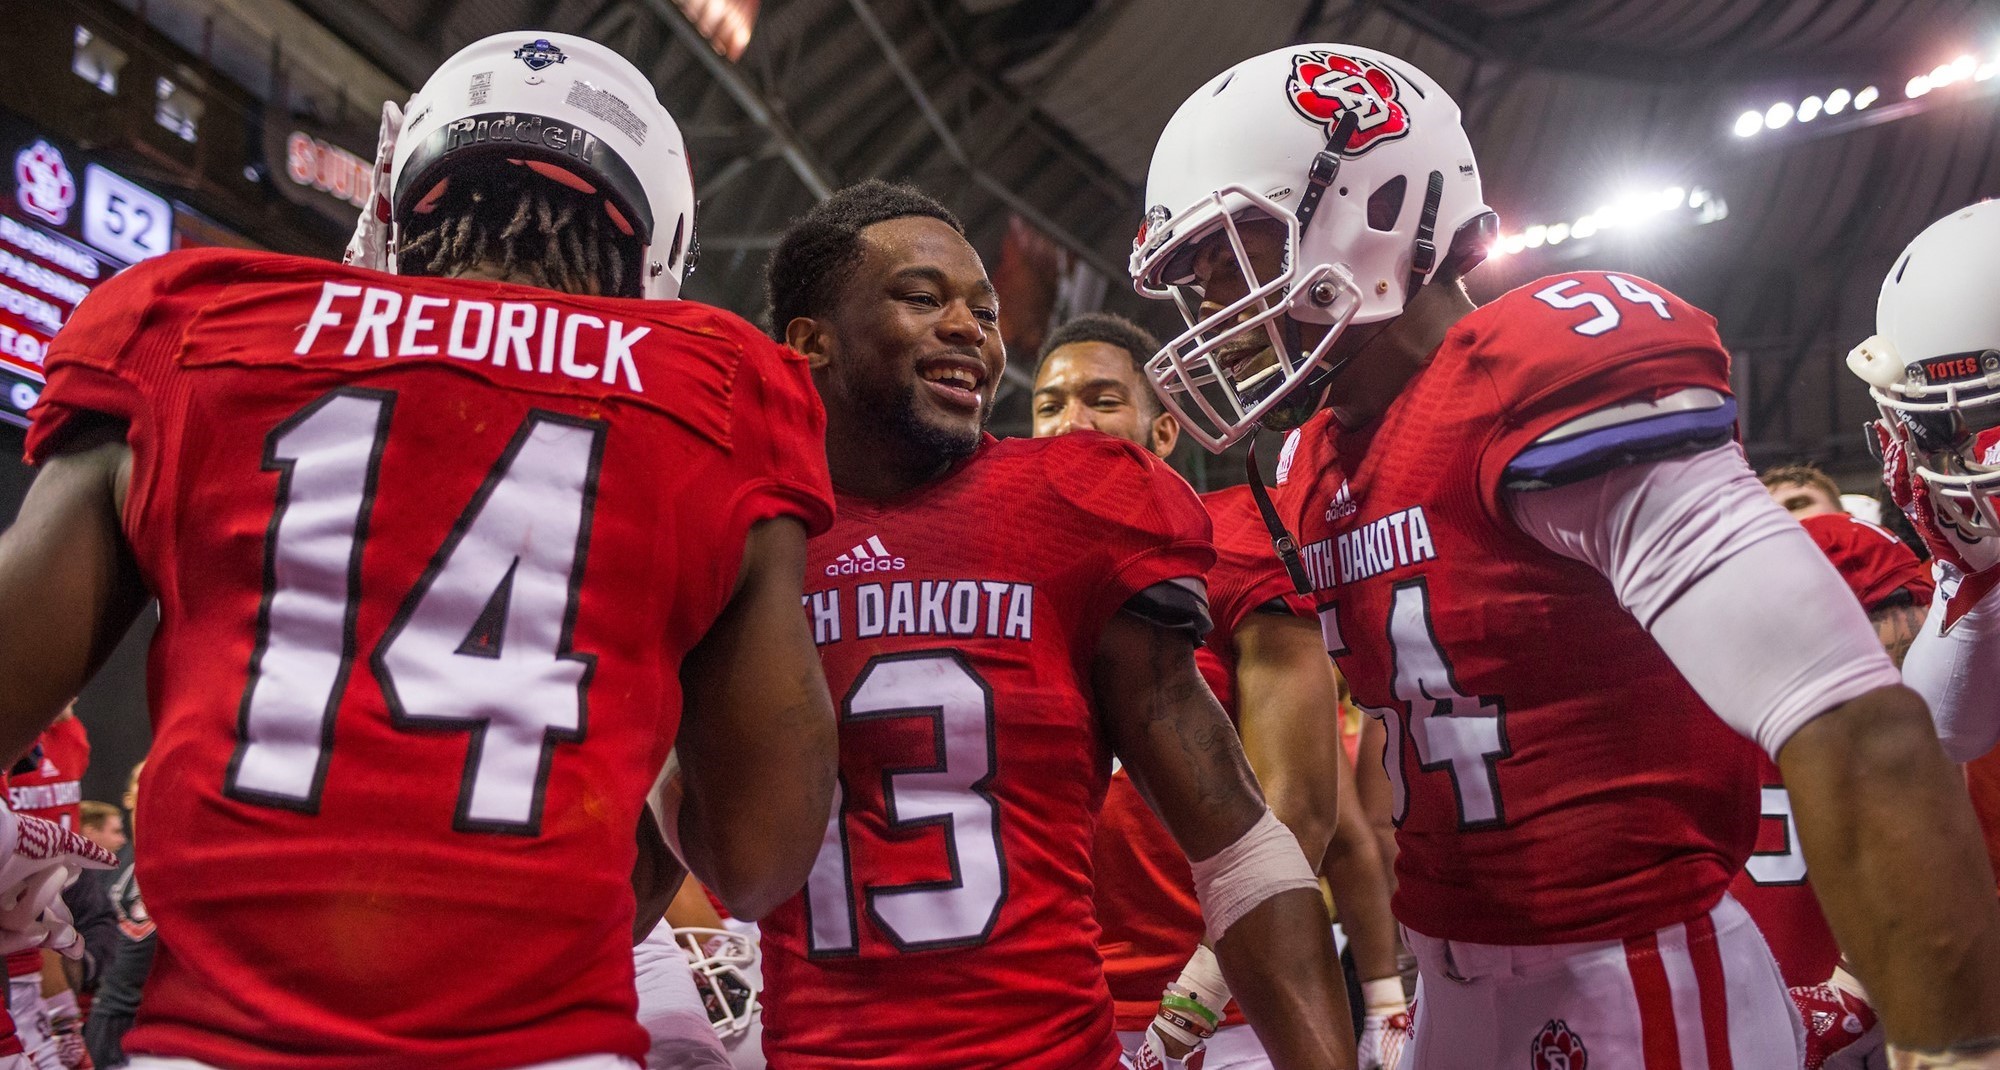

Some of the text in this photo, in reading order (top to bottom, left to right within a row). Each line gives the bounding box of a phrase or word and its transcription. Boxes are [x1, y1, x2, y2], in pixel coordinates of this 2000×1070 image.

[445, 113, 597, 164] Riddell
[105, 193, 153, 250] 52
[1265, 187, 1291, 200] PEED
[1531, 274, 1674, 338] 54
[294, 282, 652, 393] FREDRICK
[1926, 357, 1977, 380] YOTES
[1325, 500, 1357, 522] adidas
[825, 557, 906, 577] adidas
[1301, 504, 1438, 592] UTH DAKOTA
[222, 386, 610, 837] 14
[856, 579, 1035, 641] DAKOTA
